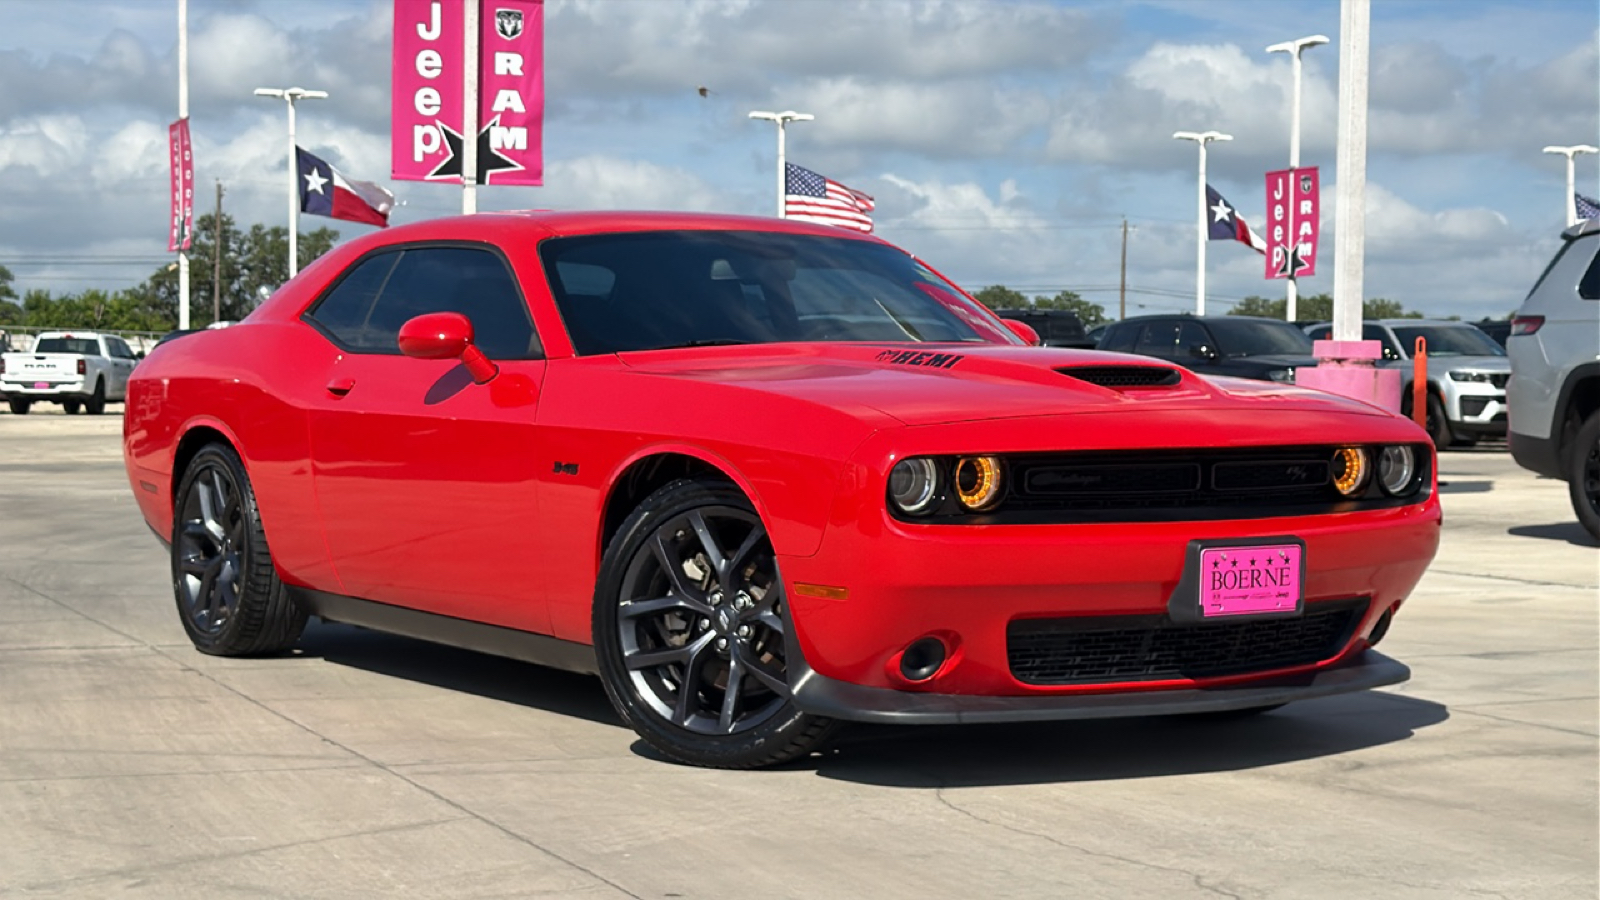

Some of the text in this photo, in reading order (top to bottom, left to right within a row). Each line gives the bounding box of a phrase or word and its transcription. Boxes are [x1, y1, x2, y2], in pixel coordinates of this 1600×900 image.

[413, 2, 443, 162] Jeep
[489, 52, 528, 150] RAM
[1272, 177, 1284, 269] Jeep
[1299, 200, 1313, 256] RAM
[890, 351, 964, 369] HEMI
[1211, 567, 1291, 591] BOERNE
